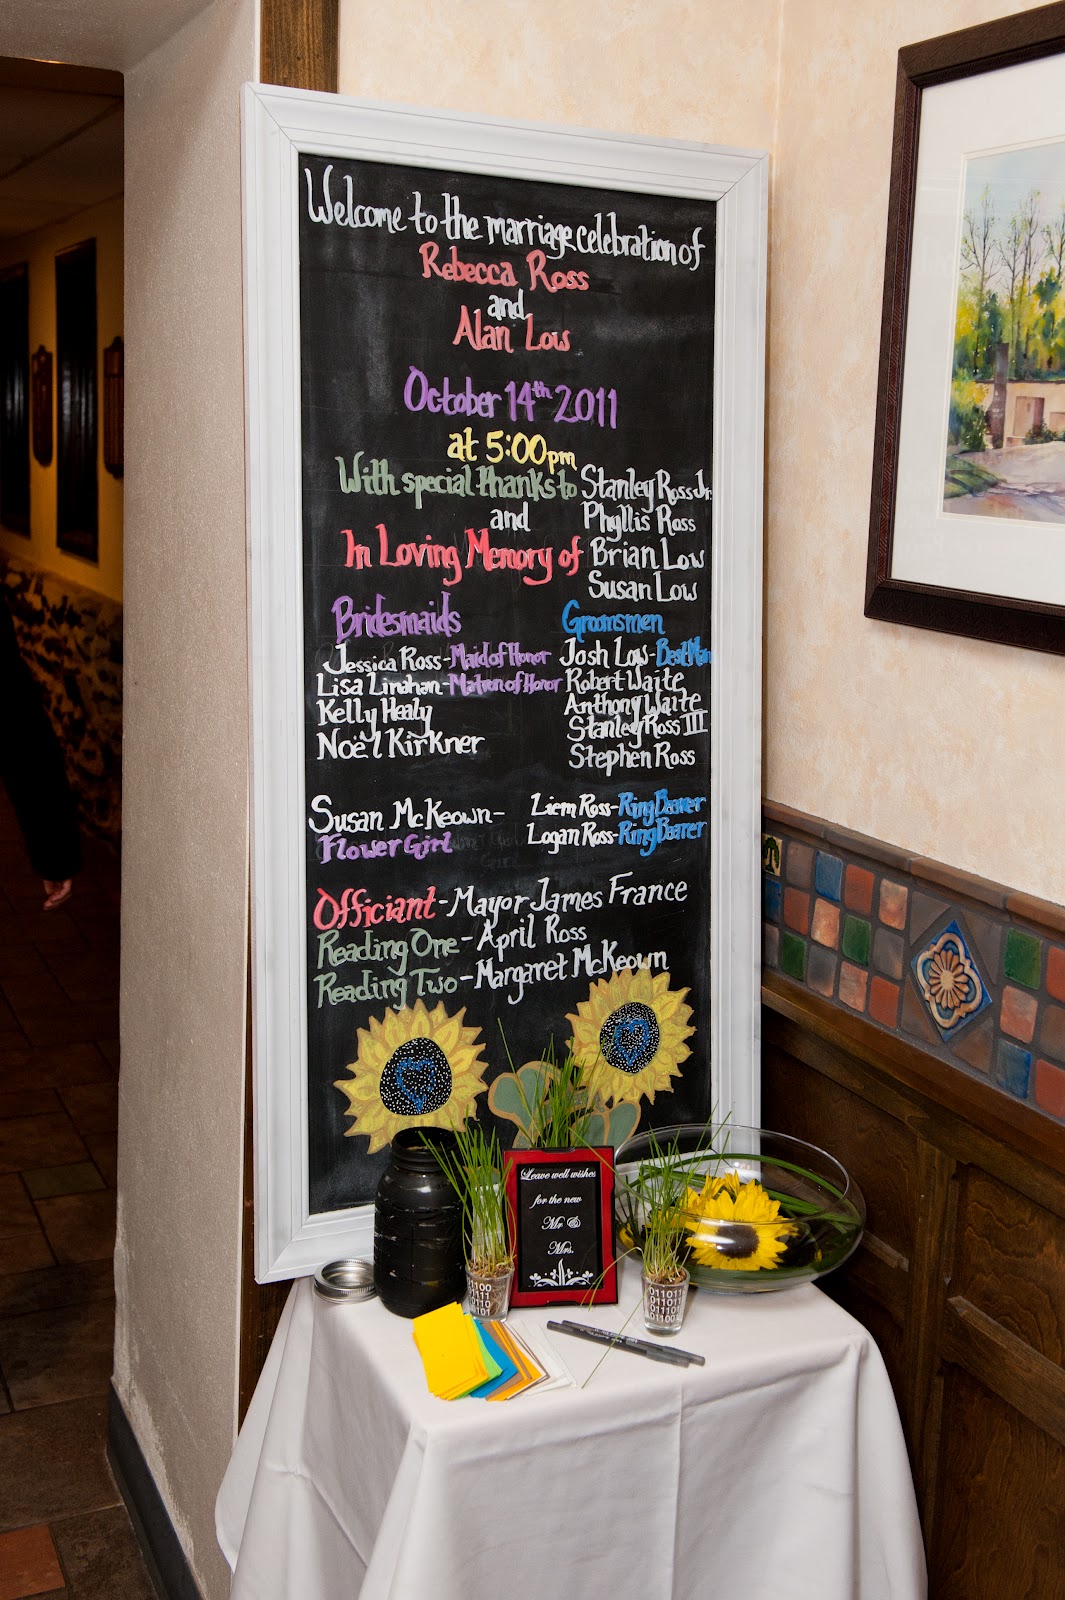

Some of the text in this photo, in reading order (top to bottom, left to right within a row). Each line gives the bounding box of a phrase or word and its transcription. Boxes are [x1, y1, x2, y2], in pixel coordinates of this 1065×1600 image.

[304, 165, 705, 270] Welcome to the marriage celebration of
[419, 242, 590, 293] Rebecca Ross
[488, 289, 526, 320] and
[452, 305, 570, 354] Alan Low
[404, 366, 617, 429] October 14th 2011
[447, 427, 478, 462] at
[335, 451, 578, 510] With special thanks to
[581, 464, 656, 513] Stanley
[655, 469, 693, 506] Ross
[490, 502, 530, 532] and
[580, 501, 696, 542] Phyllis Ross
[340, 523, 584, 586] In Loving Memory of
[590, 536, 704, 570] Brian Low
[588, 570, 697, 602] Susan Low
[331, 591, 461, 644] Bridesmaids
[322, 642, 398, 674] Jessica
[449, 642, 489, 670] Maid
[489, 642, 507, 668] of
[507, 642, 552, 667] Honor
[559, 637, 610, 668] Josh
[316, 672, 363, 696] Lisa
[448, 672, 505, 696] Matron
[505, 671, 524, 694] of
[522, 673, 564, 694] Honor
[565, 665, 685, 694] Robert Waite
[316, 697, 433, 742] Kelly Healy
[564, 690, 702, 734] Anthony Waite
[567, 710, 708, 748] Stanley Ross III
[568, 741, 696, 776] Stephen Ross
[308, 795, 384, 833] Susan
[530, 792, 576, 818] Liem
[618, 792, 655, 826] Ring
[318, 833, 402, 864] Flower
[404, 832, 453, 860] Girl
[527, 822, 580, 854] Logan
[618, 820, 656, 856] Ring
[446, 885, 529, 928] Mayor
[530, 877, 602, 911] James
[608, 872, 688, 906] France
[316, 928, 408, 975] Reading
[477, 913, 536, 962] April
[544, 916, 587, 946] Ross
[313, 968, 408, 1010] Reading
[474, 951, 569, 1004] Margaret
[572, 940, 668, 979] McKeown
[520, 1168, 596, 1181] Leave well wishes
[528, 1194, 582, 1209] for the new
[541, 1216, 581, 1231] Mr &
[547, 1241, 574, 1256] Mrs.
